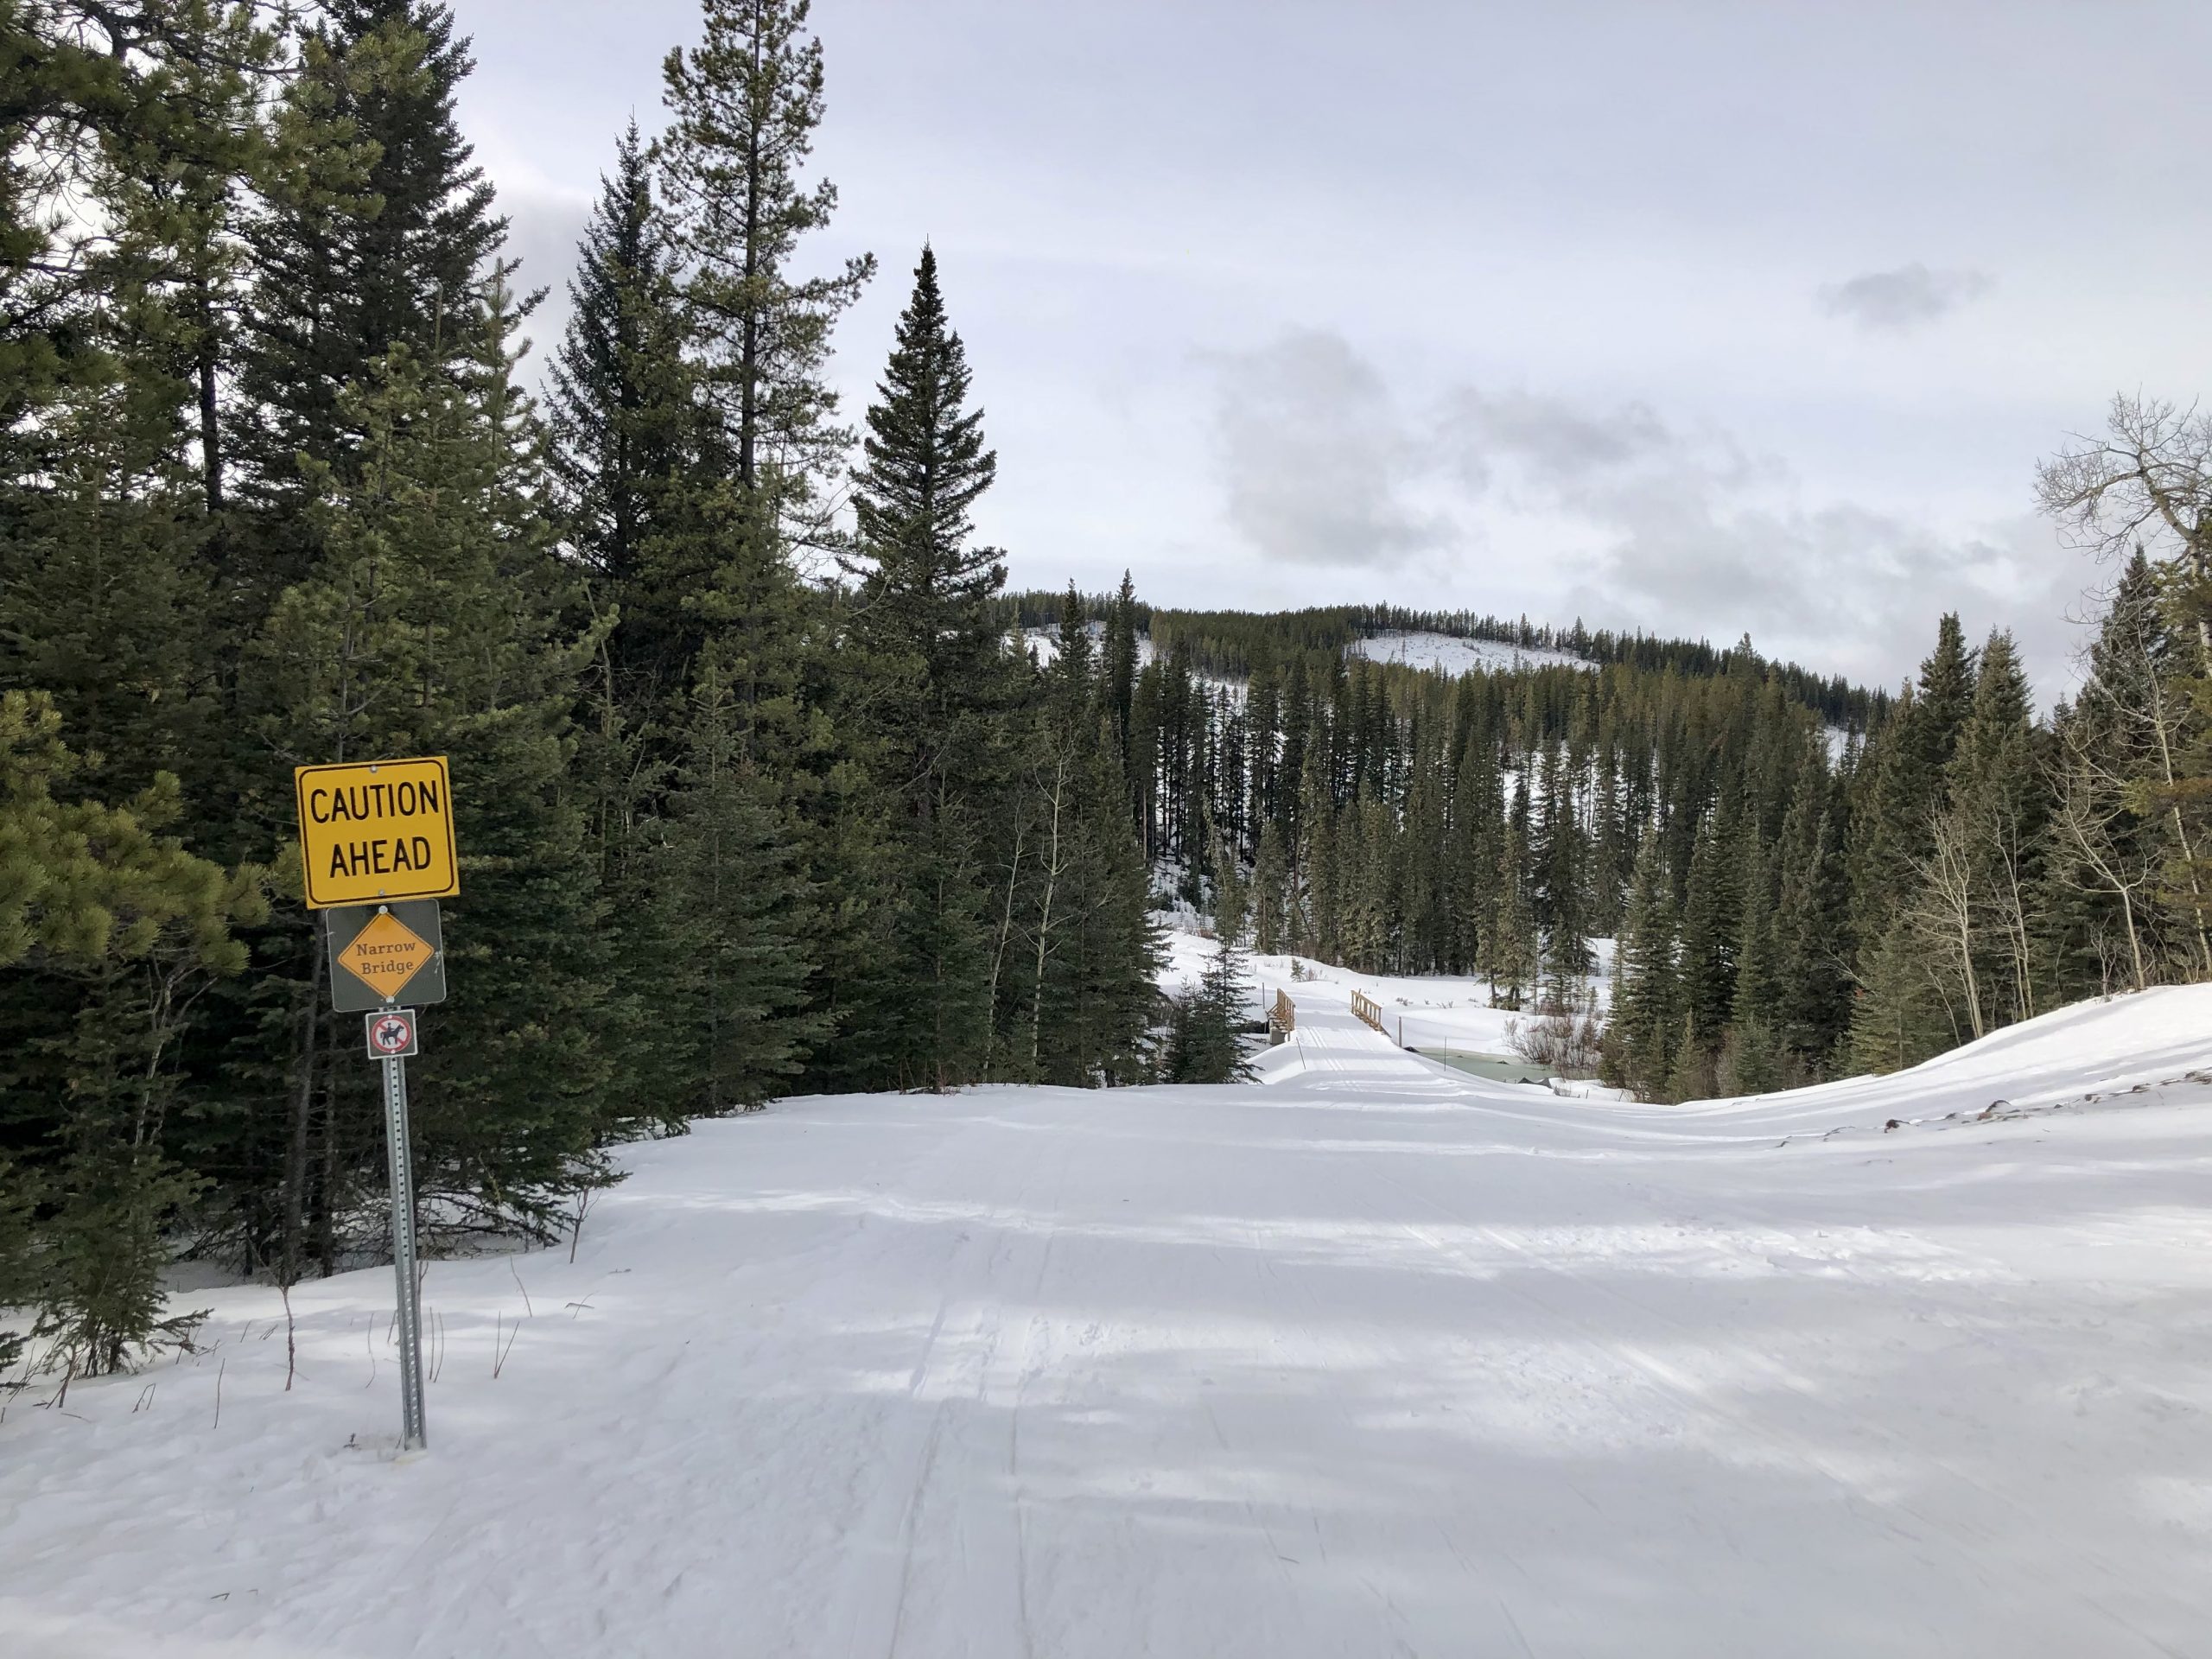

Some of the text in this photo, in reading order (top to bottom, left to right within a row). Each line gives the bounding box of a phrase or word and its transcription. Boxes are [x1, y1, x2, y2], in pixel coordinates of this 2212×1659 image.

[311, 779, 439, 823] CAUTION
[329, 836, 431, 879] AHEAD
[356, 941, 416, 957] Narrow
[360, 959, 415, 976] Bridge
